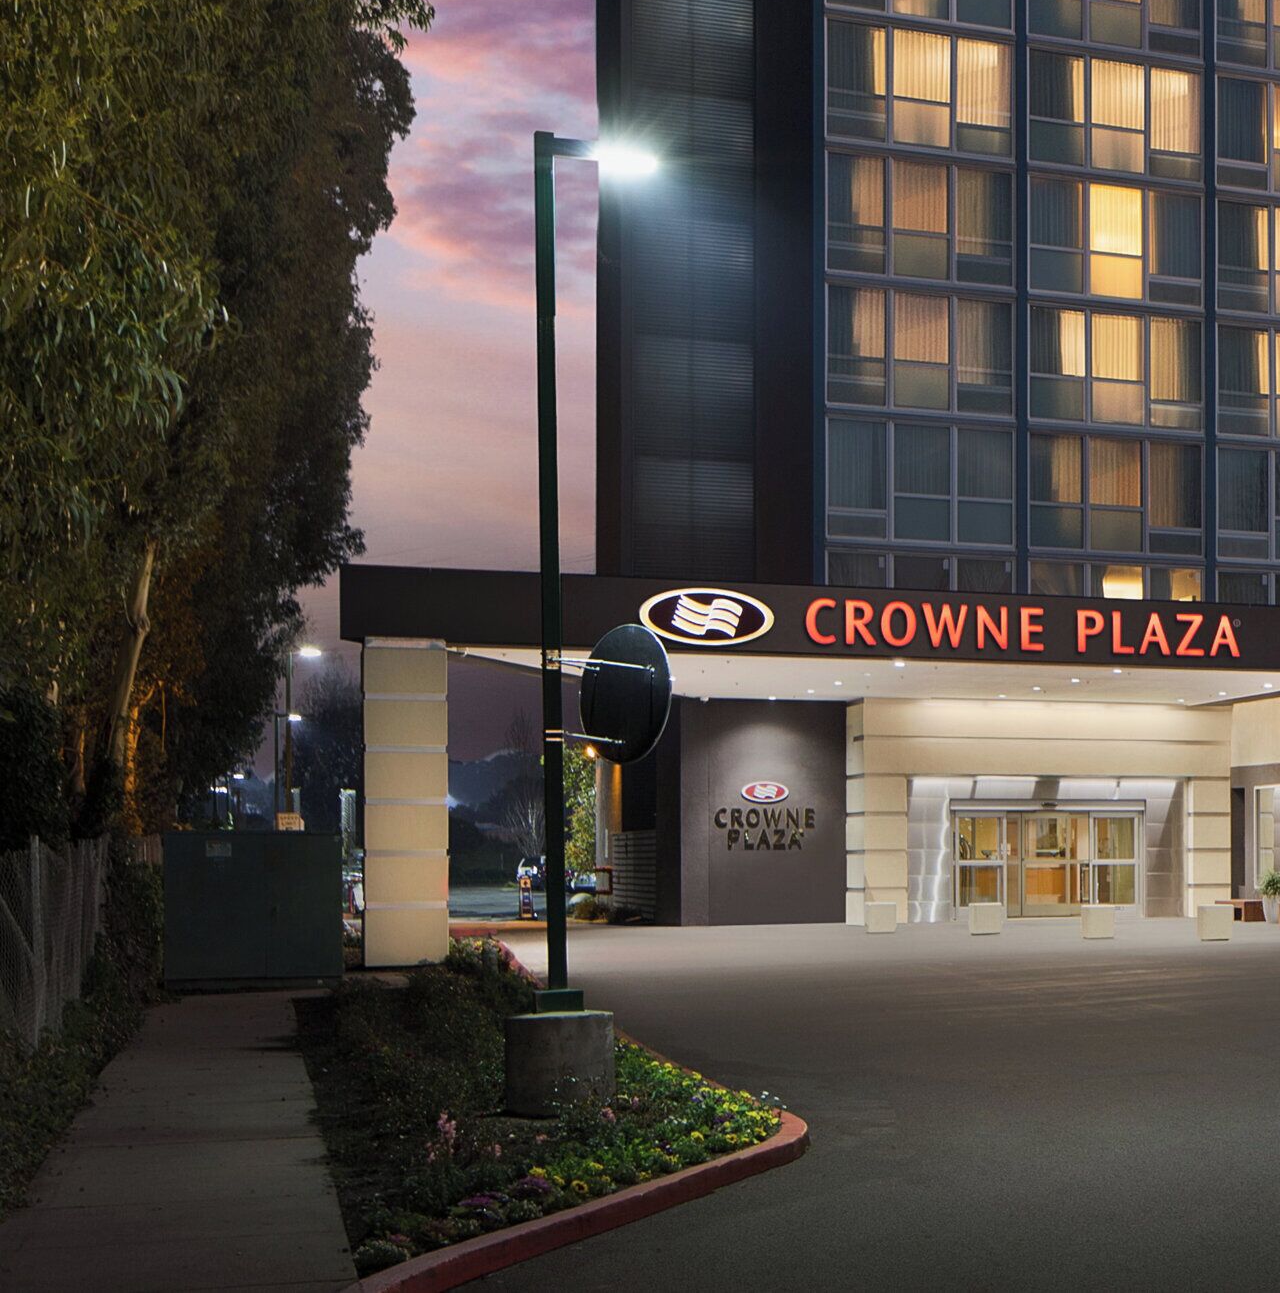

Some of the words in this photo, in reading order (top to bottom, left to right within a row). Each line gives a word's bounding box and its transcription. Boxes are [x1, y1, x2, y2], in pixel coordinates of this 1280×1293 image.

[805, 597, 1044, 652] CROWNE
[1077, 609, 1241, 658] PLAZA
[713, 807, 816, 830] CROWNE
[727, 829, 804, 851] PLAZA
